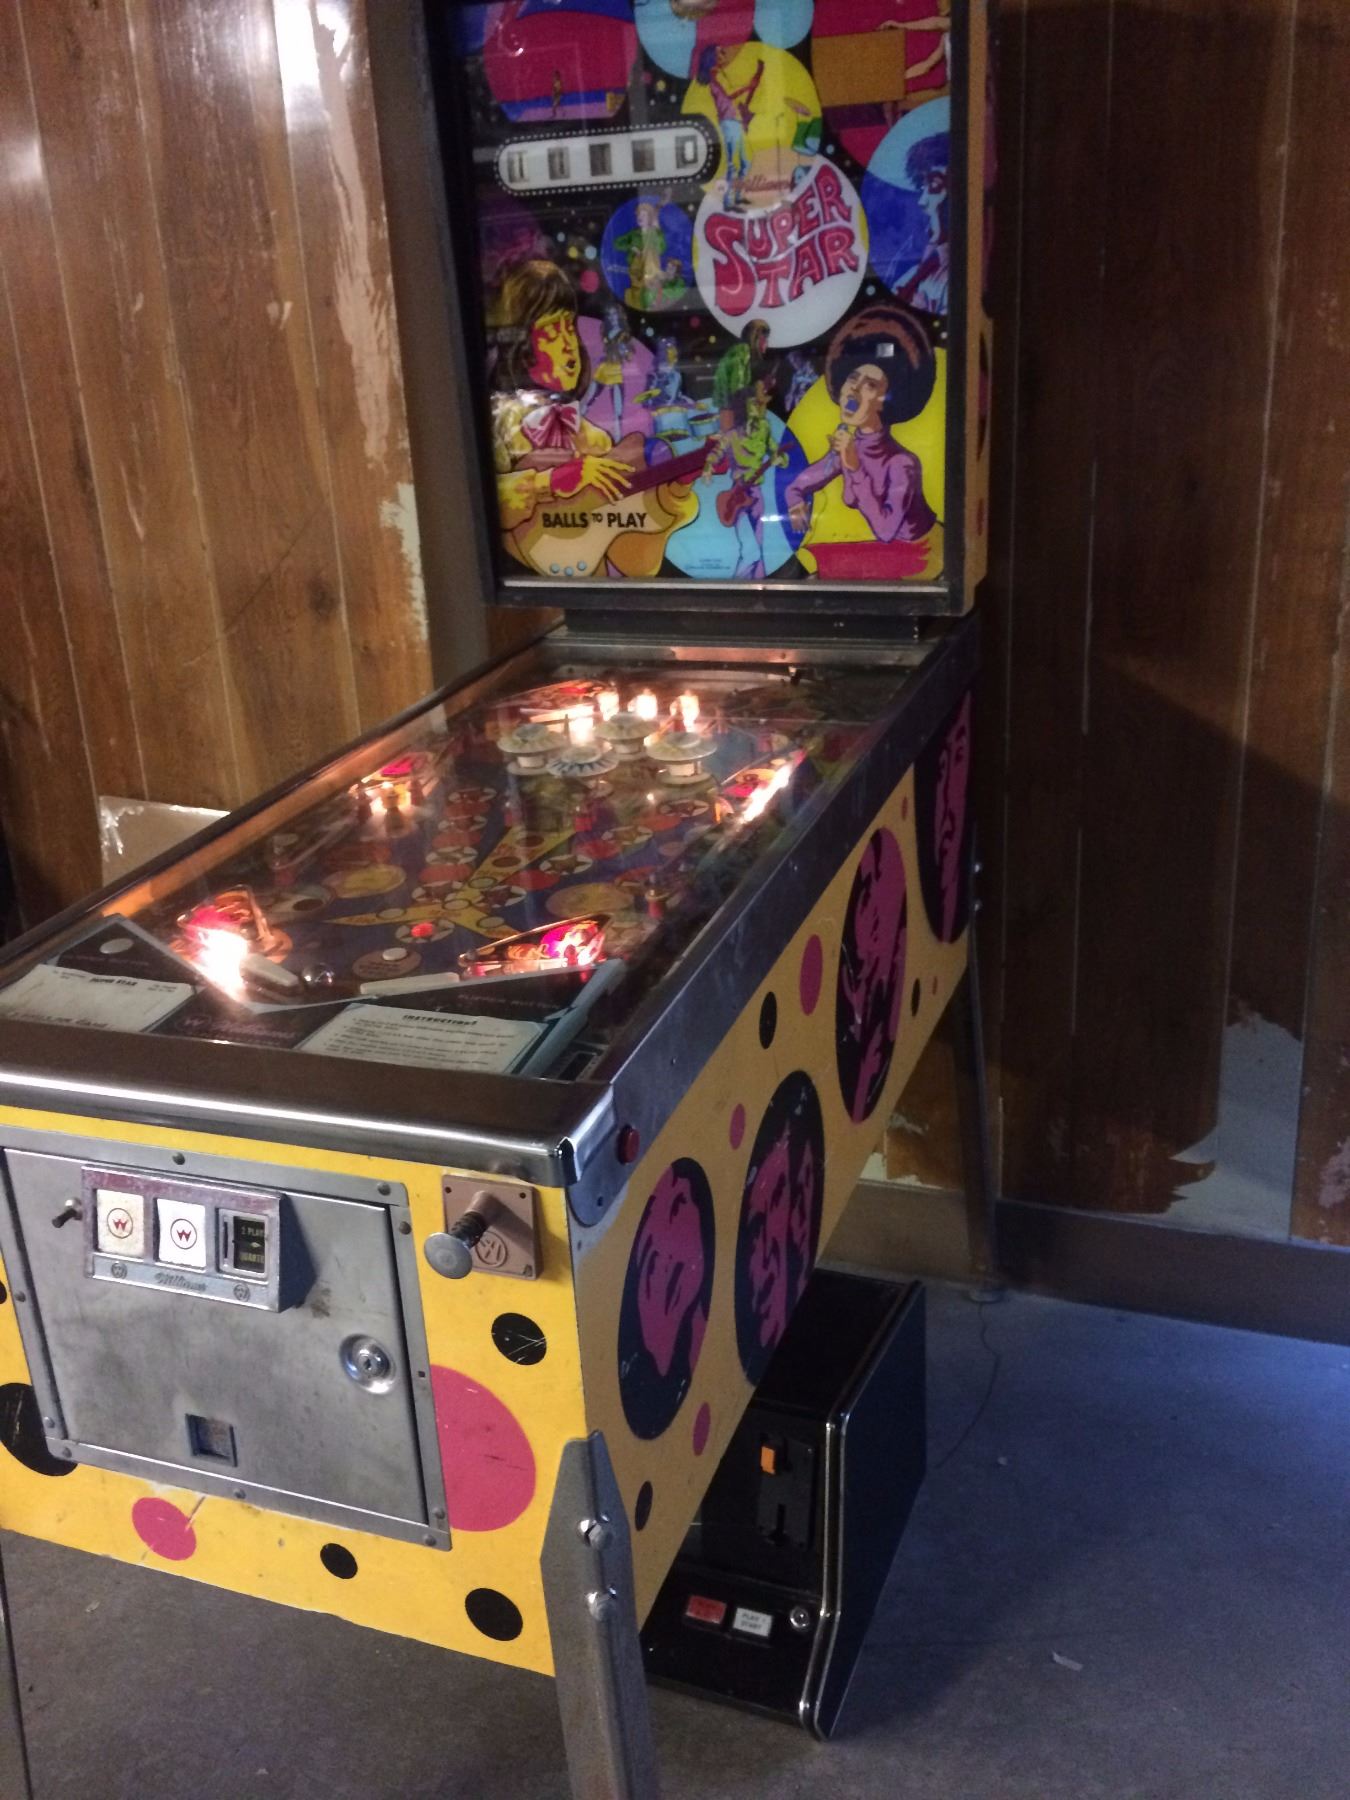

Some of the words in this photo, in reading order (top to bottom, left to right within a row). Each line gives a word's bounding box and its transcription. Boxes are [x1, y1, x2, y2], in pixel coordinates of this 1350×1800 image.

[704, 164, 851, 316] SUPER
[542, 512, 588, 528] BALLS
[592, 513, 603, 523] TO
[607, 512, 647, 528] PLAY
